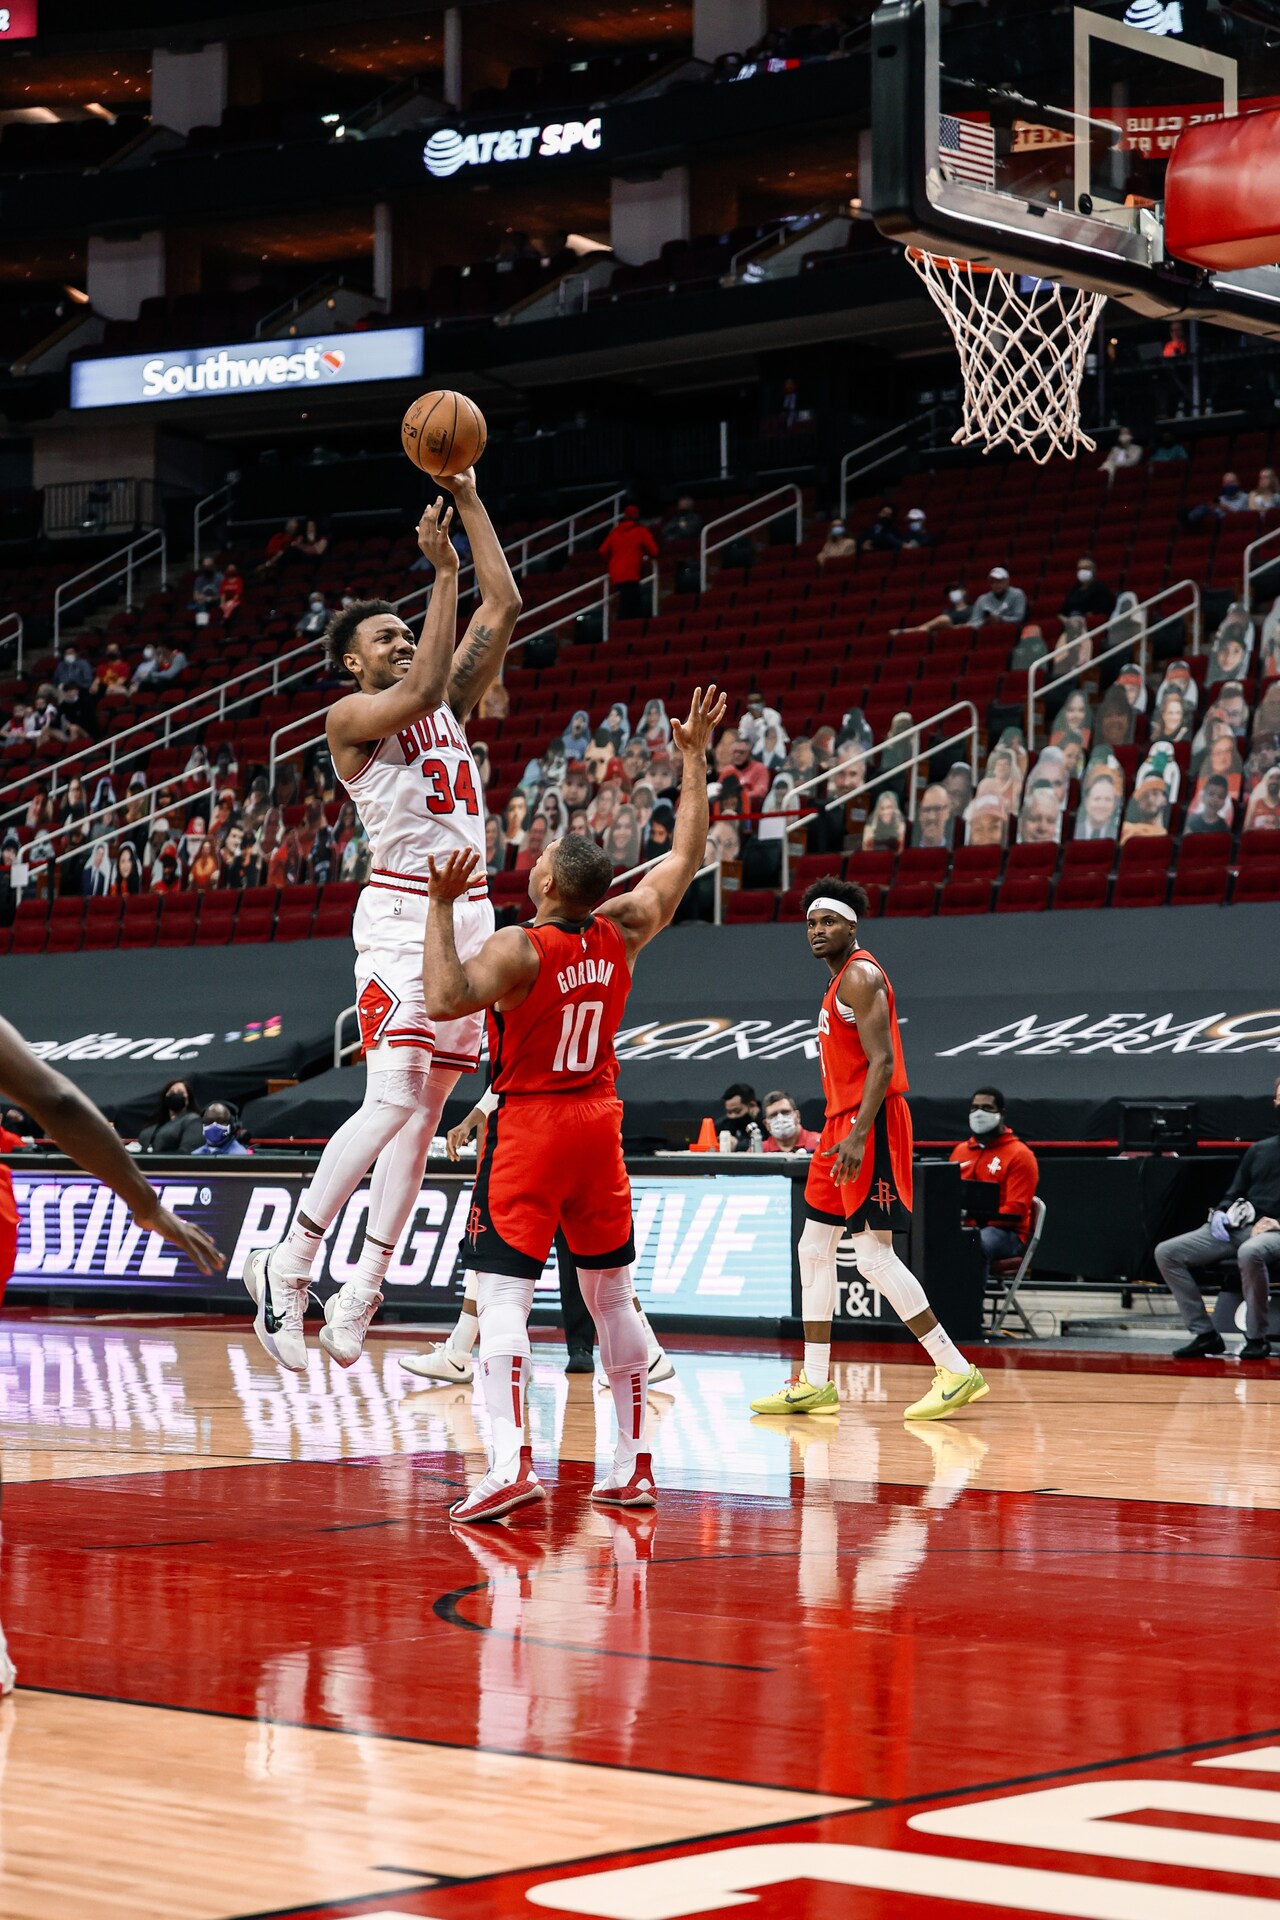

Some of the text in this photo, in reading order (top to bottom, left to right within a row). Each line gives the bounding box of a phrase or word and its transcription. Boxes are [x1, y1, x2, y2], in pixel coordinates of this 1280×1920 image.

[461, 126, 541, 165] AT&T
[142, 349, 322, 397] Southwest
[396, 711, 471, 767] BULL
[421, 758, 479, 817] 34
[556, 958, 615, 994] GORDON
[24, 1032, 215, 1061] eliant
[552, 1000, 604, 1072] 10
[13, 1184, 200, 1278] SSIVE
[833, 1280, 883, 1318] T&T
